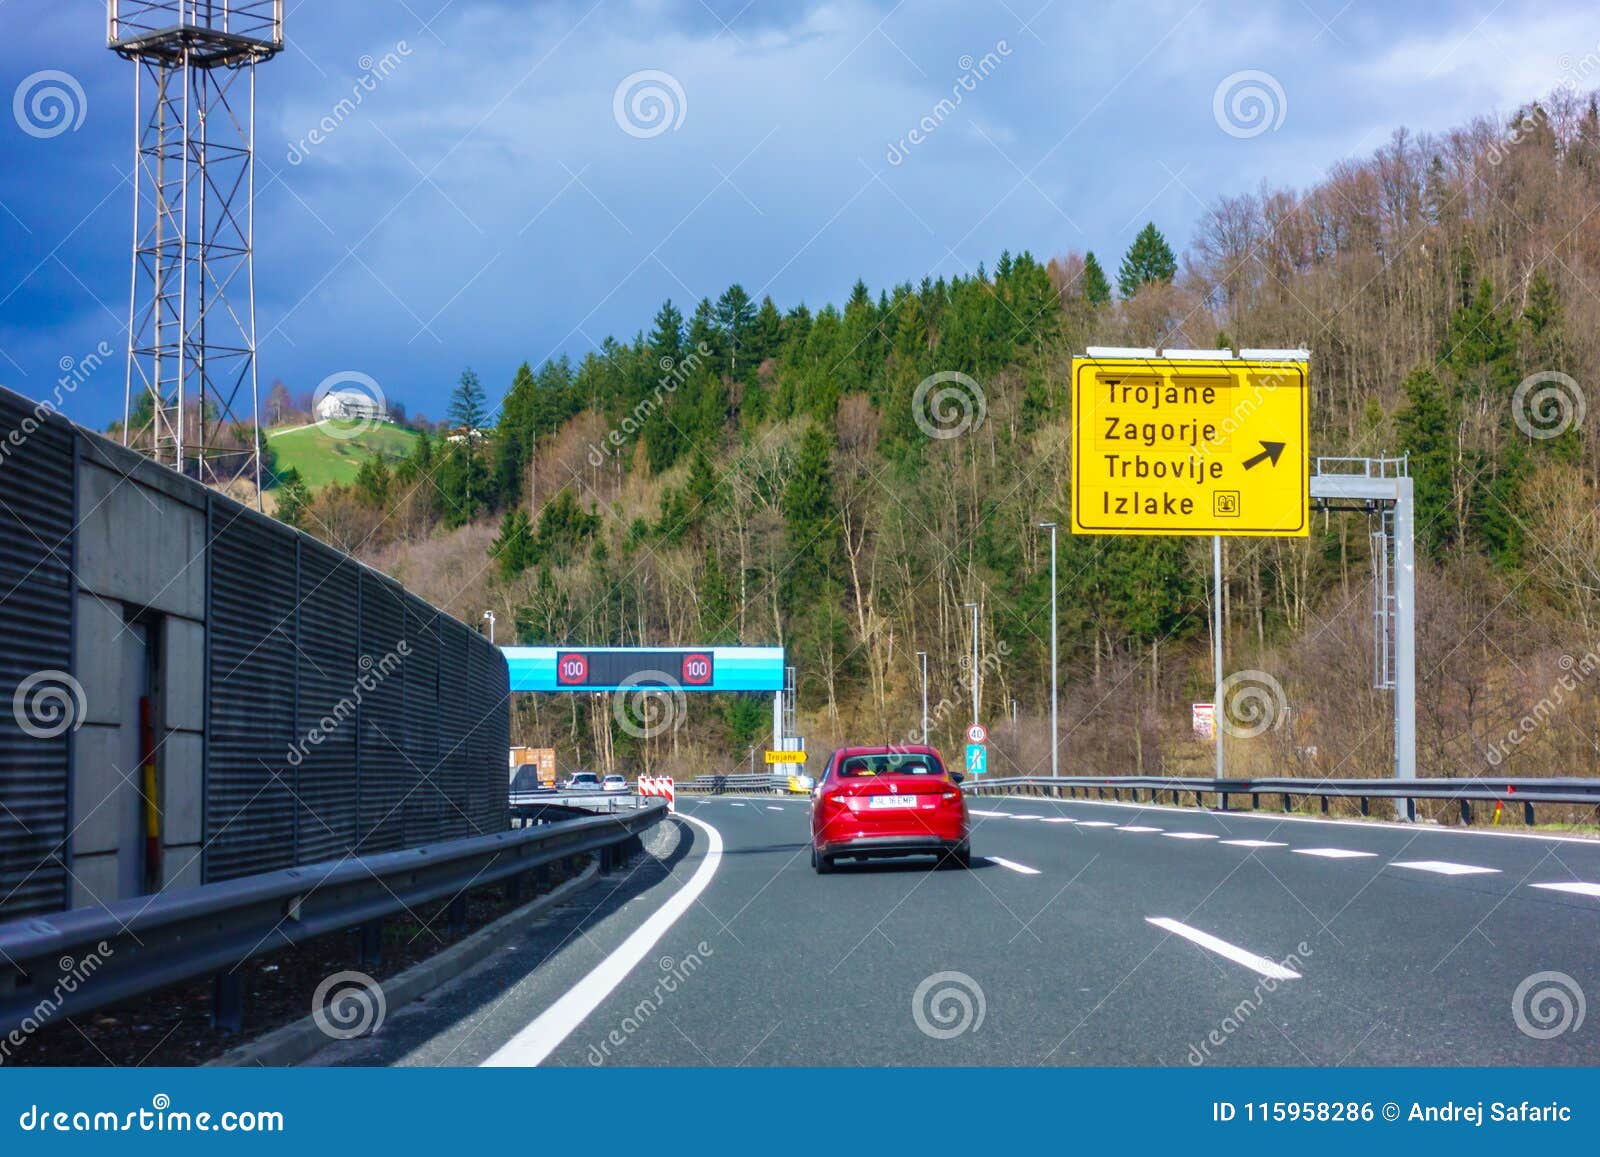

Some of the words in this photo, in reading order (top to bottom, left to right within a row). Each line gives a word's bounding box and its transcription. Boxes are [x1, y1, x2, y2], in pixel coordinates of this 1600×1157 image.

[1104, 380, 1216, 409] Trojane
[1104, 417, 1216, 446] Zagorje
[1103, 454, 1223, 484] Trbovlje
[1103, 491, 1194, 515] Izlake
[562, 662, 584, 676] 100
[686, 662, 708, 676] 100
[971, 729, 983, 738] 40
[768, 753, 797, 762] Trojane
